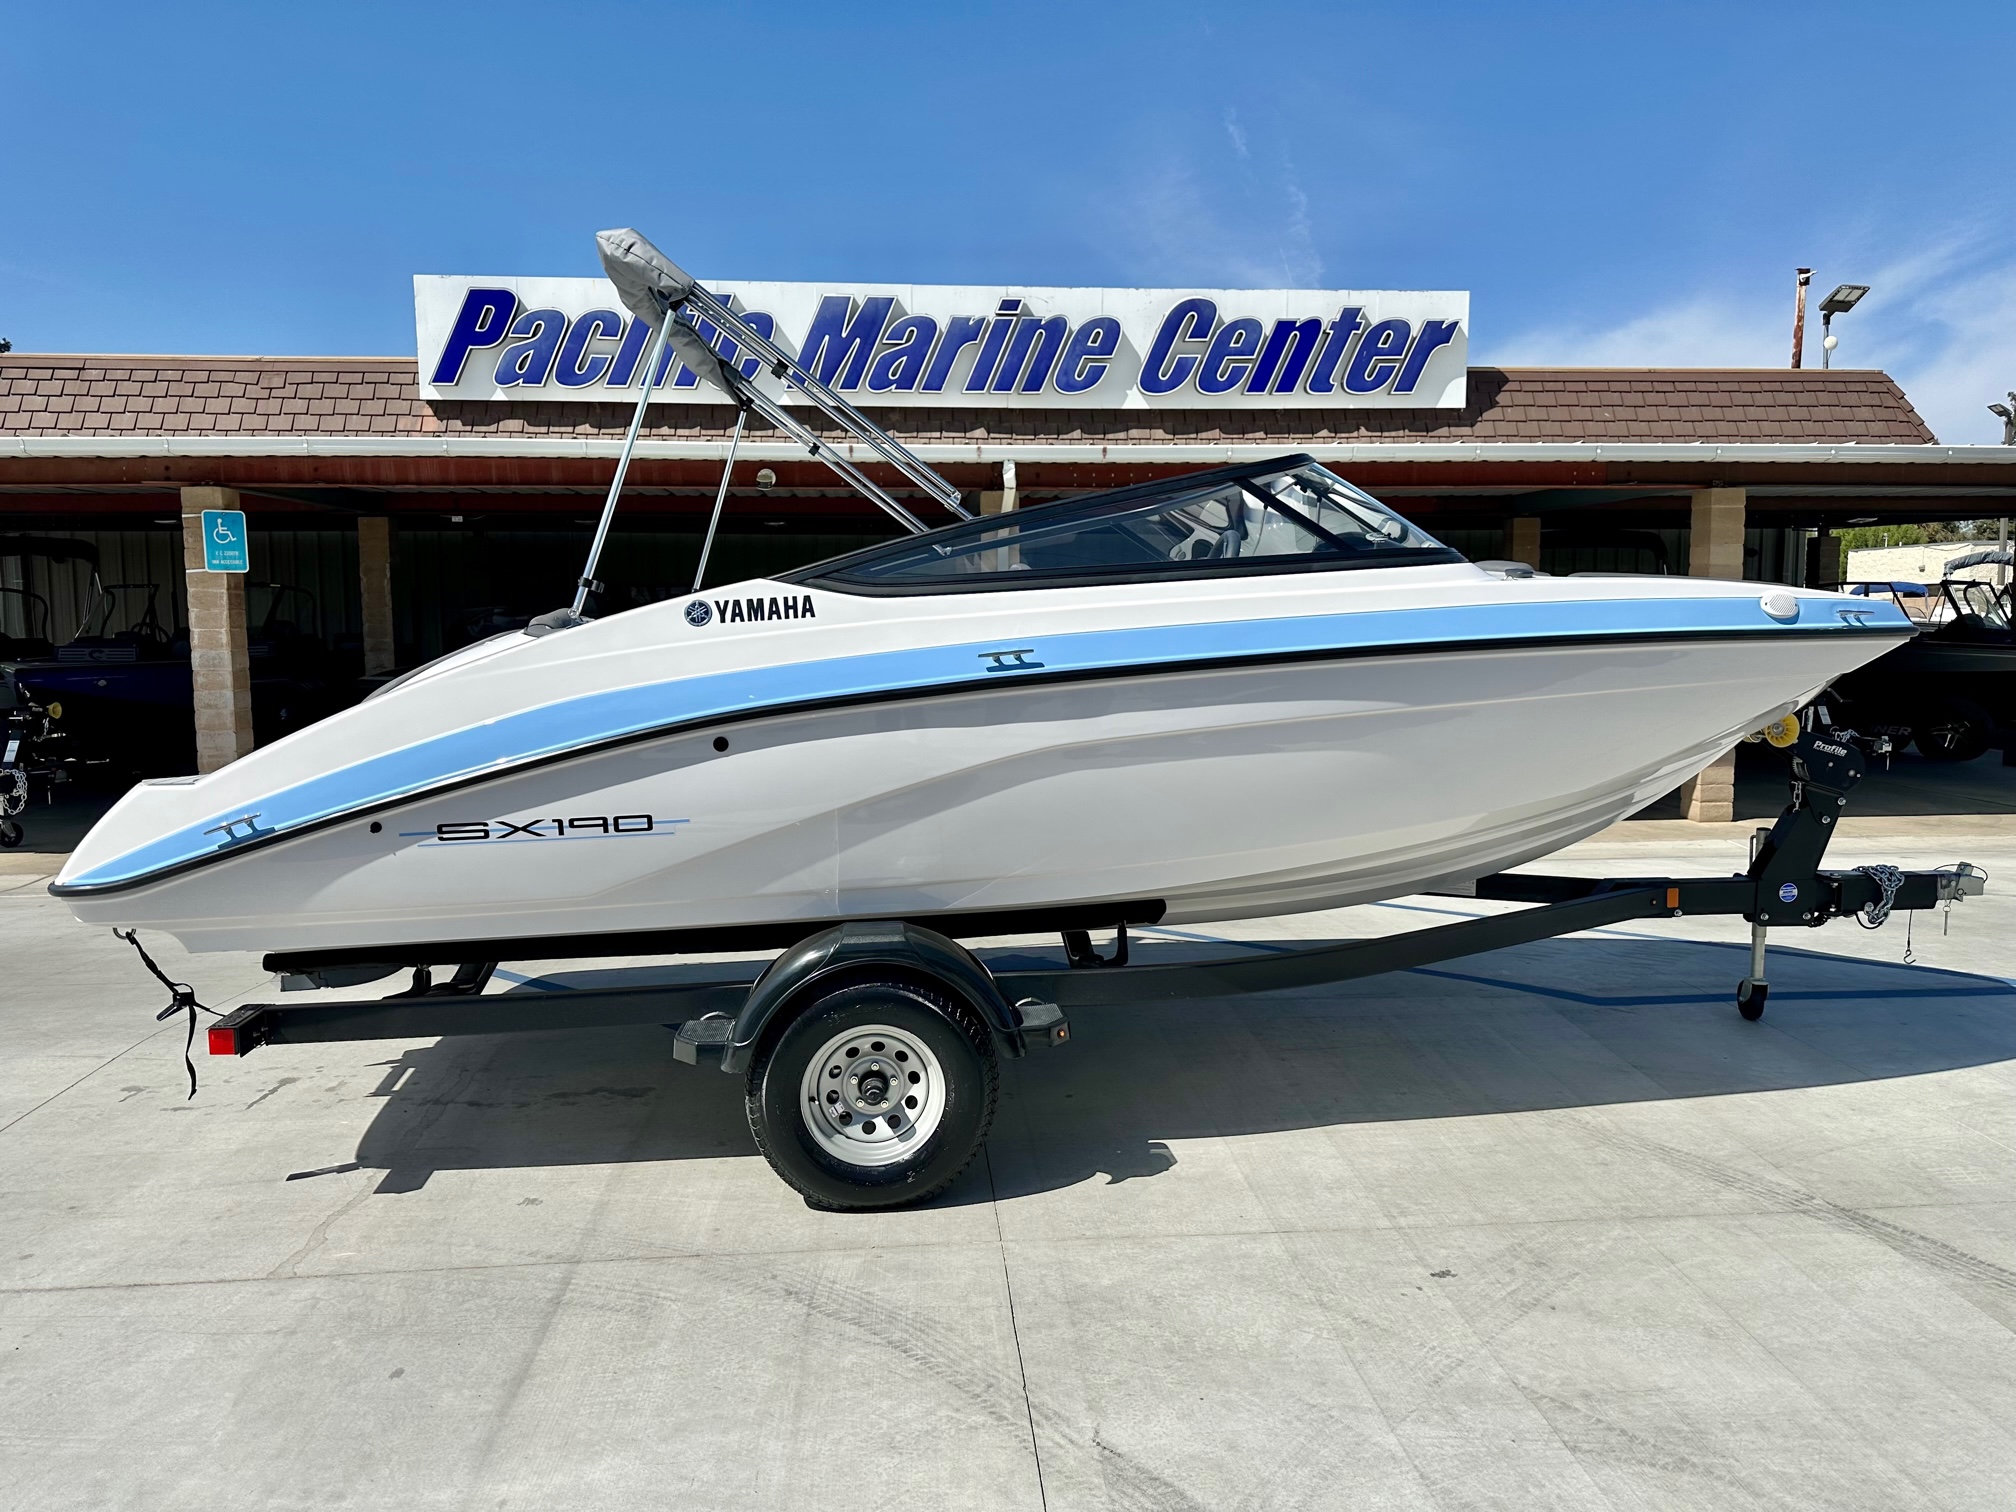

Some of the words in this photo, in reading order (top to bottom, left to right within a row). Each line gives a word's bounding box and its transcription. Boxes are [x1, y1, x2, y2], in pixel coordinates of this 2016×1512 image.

[786, 293, 1123, 396] Marine
[1137, 296, 1462, 397] Center
[714, 595, 816, 624] YAMAHA
[1813, 740, 1848, 755] Profile
[436, 814, 654, 841] SX190
